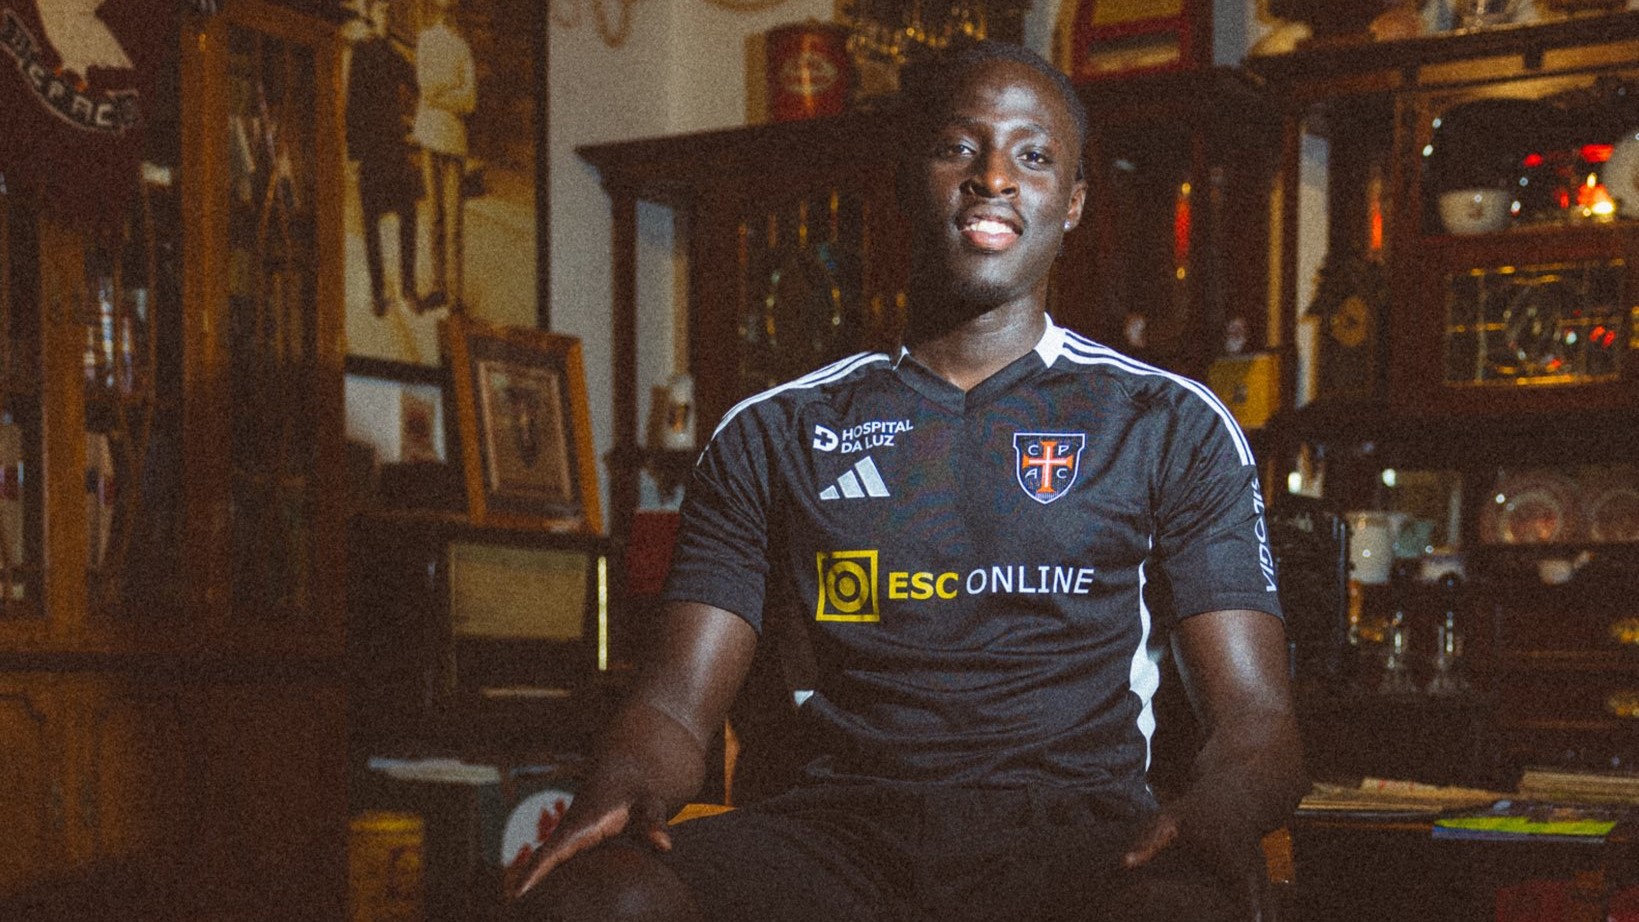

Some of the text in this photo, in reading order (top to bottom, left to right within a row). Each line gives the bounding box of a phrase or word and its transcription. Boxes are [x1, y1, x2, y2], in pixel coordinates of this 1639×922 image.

[842, 419, 914, 441] HOSPITAL
[841, 434, 895, 454] DA LUZ
[888, 565, 1095, 600] ESC ONLINE
